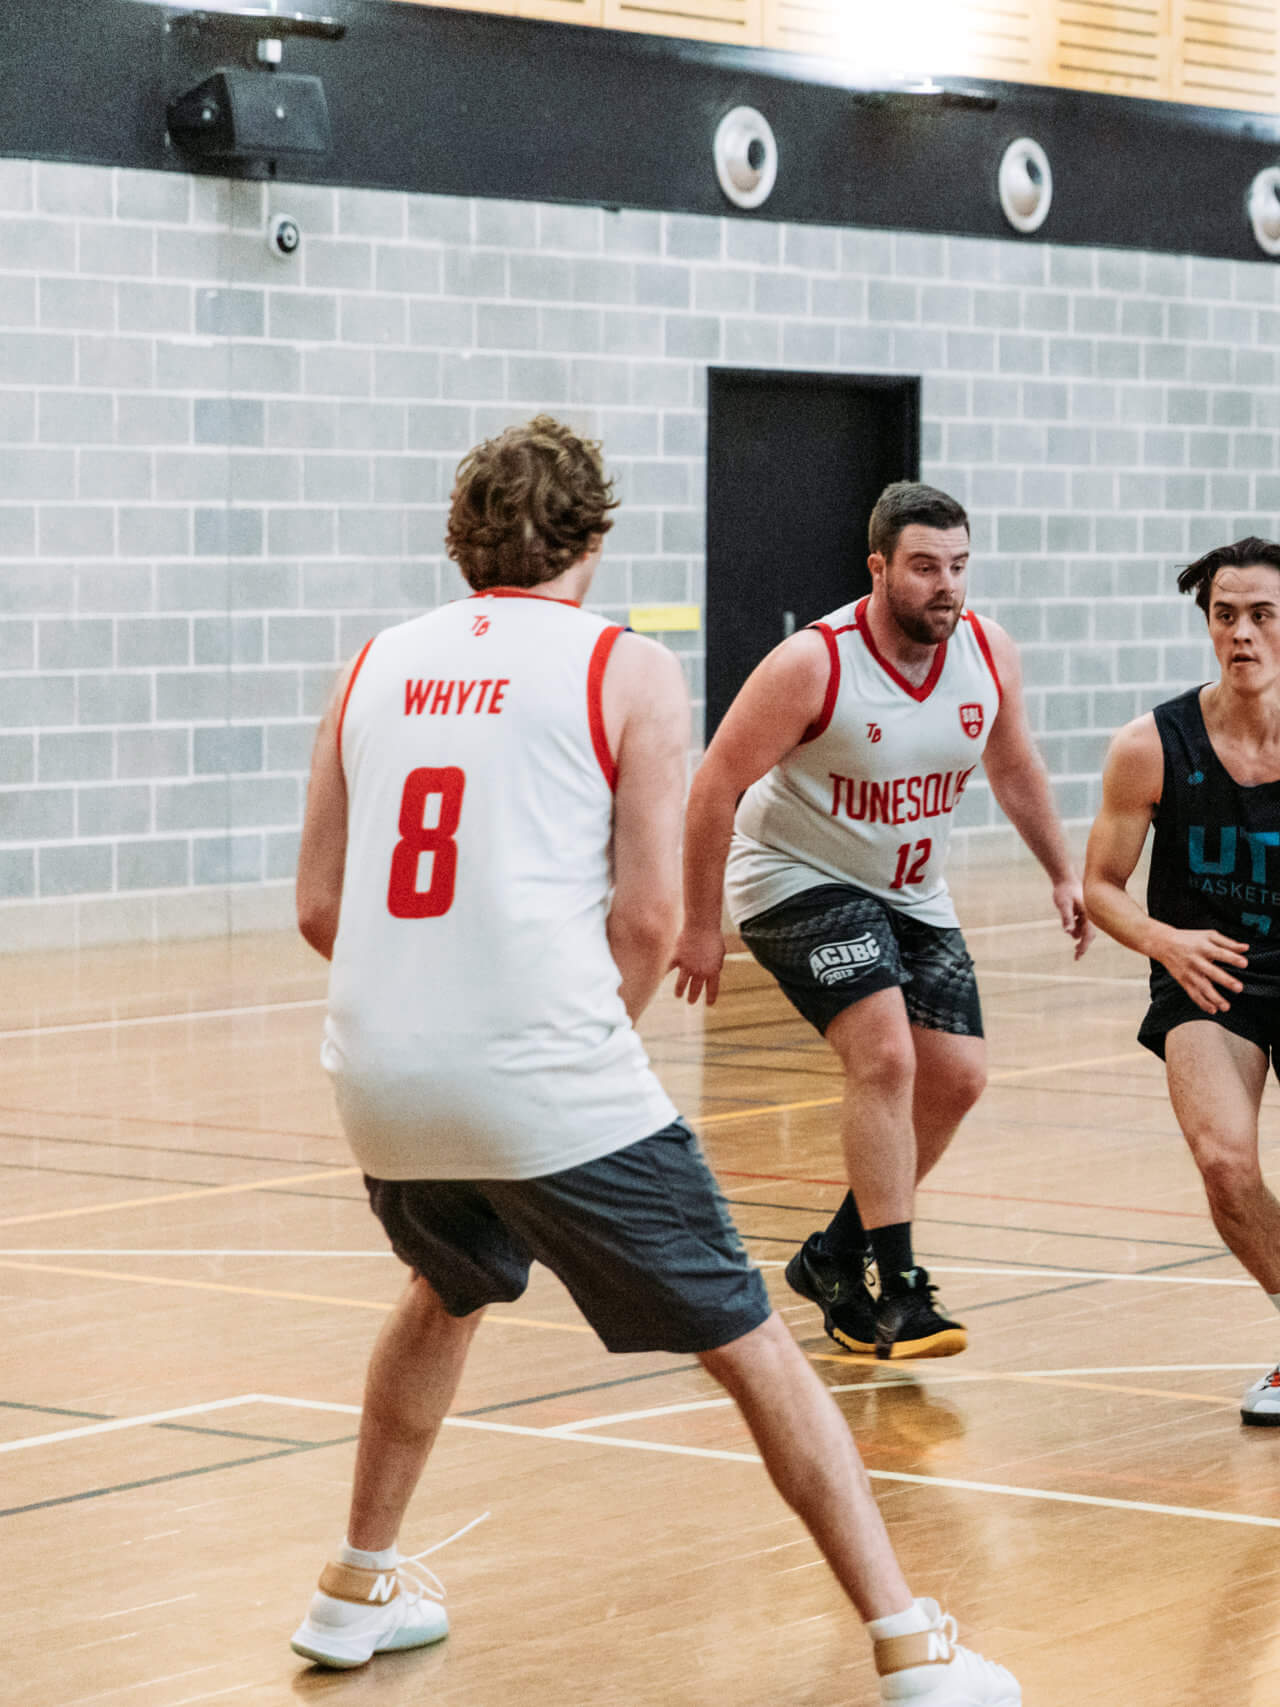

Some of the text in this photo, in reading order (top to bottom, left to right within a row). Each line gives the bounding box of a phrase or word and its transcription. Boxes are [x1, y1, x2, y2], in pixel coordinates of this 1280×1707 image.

[471, 615, 491, 636] TB
[404, 678, 511, 716] WHYTE
[866, 723, 882, 743] TB
[386, 765, 466, 919] 8
[889, 837, 932, 890] 12
